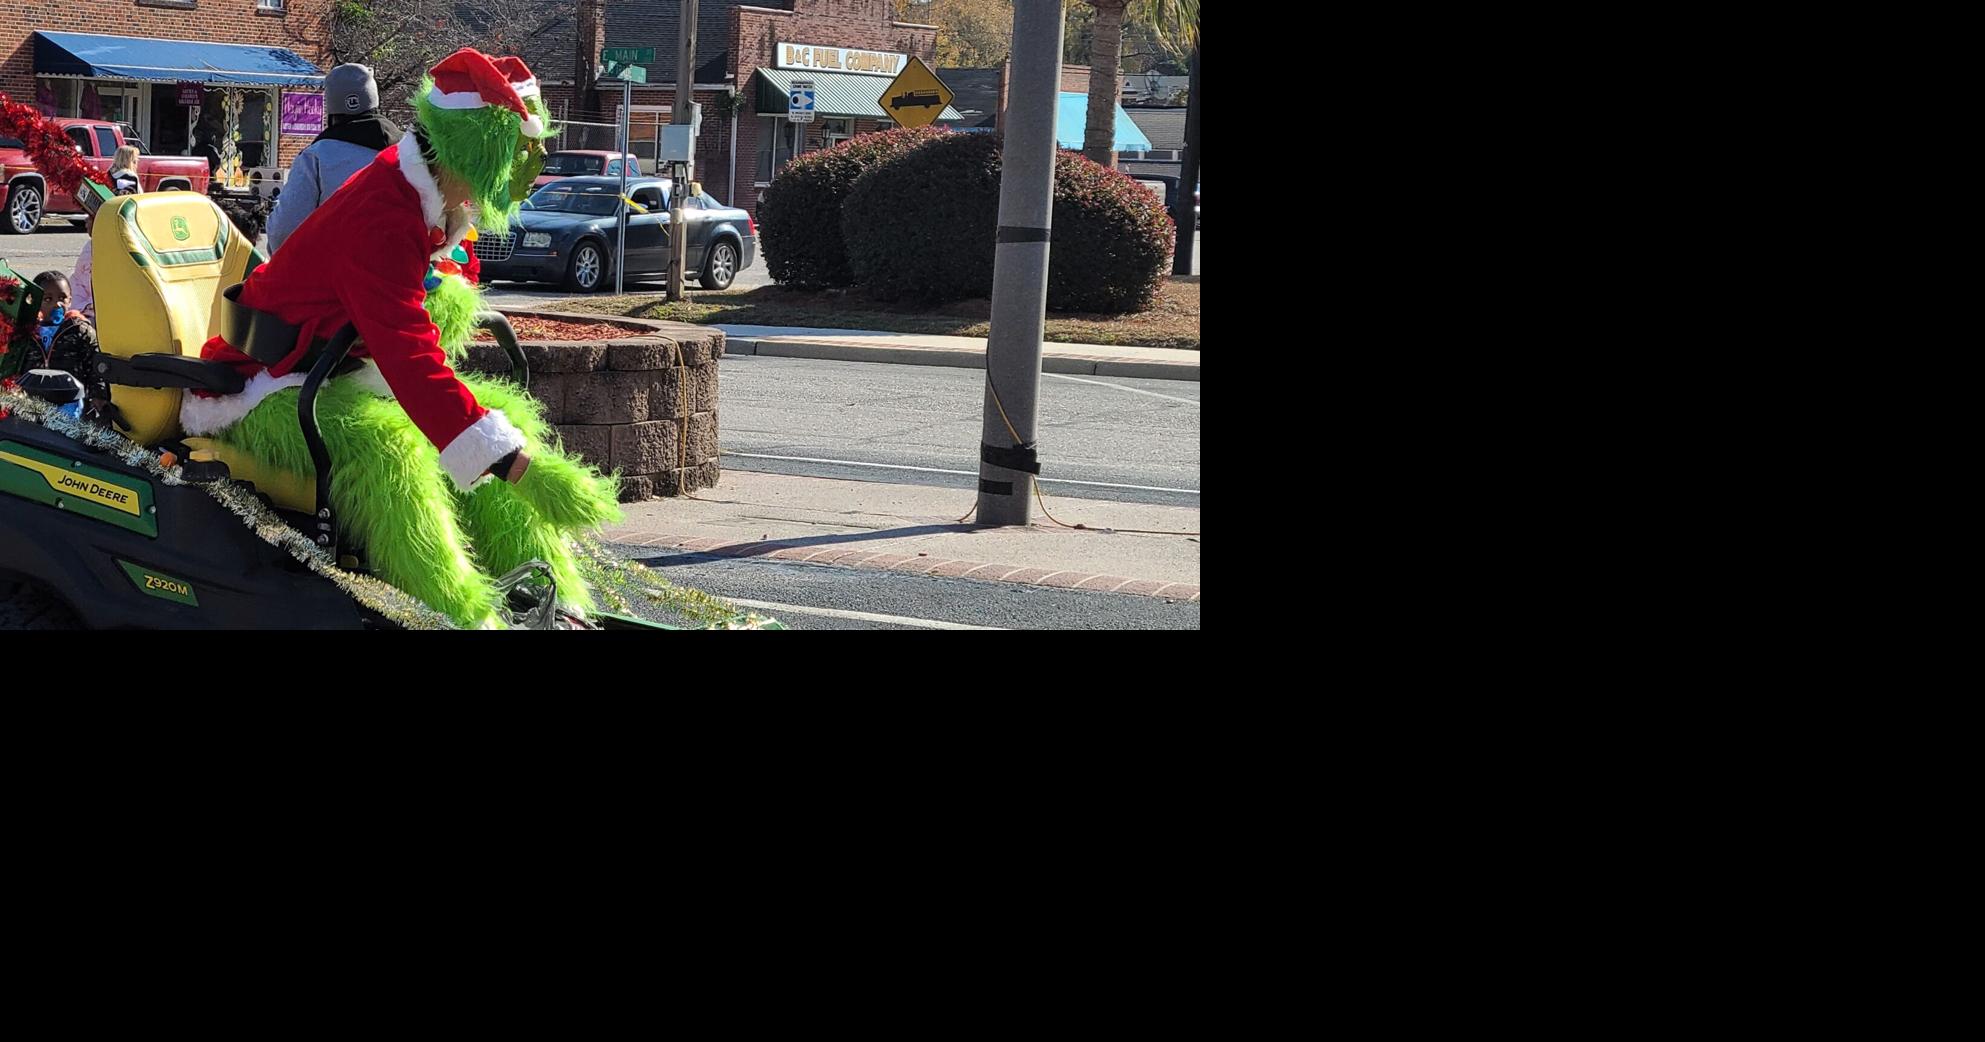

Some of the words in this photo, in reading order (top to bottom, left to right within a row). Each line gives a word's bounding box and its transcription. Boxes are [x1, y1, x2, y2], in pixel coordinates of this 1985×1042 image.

[602, 49, 609, 61] E
[615, 49, 638, 61] MAIN
[786, 45, 809, 66] B&C
[813, 47, 841, 69] FUEL
[845, 51, 900, 74] COMPANY
[58, 475, 89, 492] JOHN
[89, 483, 129, 504] DEERE
[144, 574, 188, 596] Z920M
